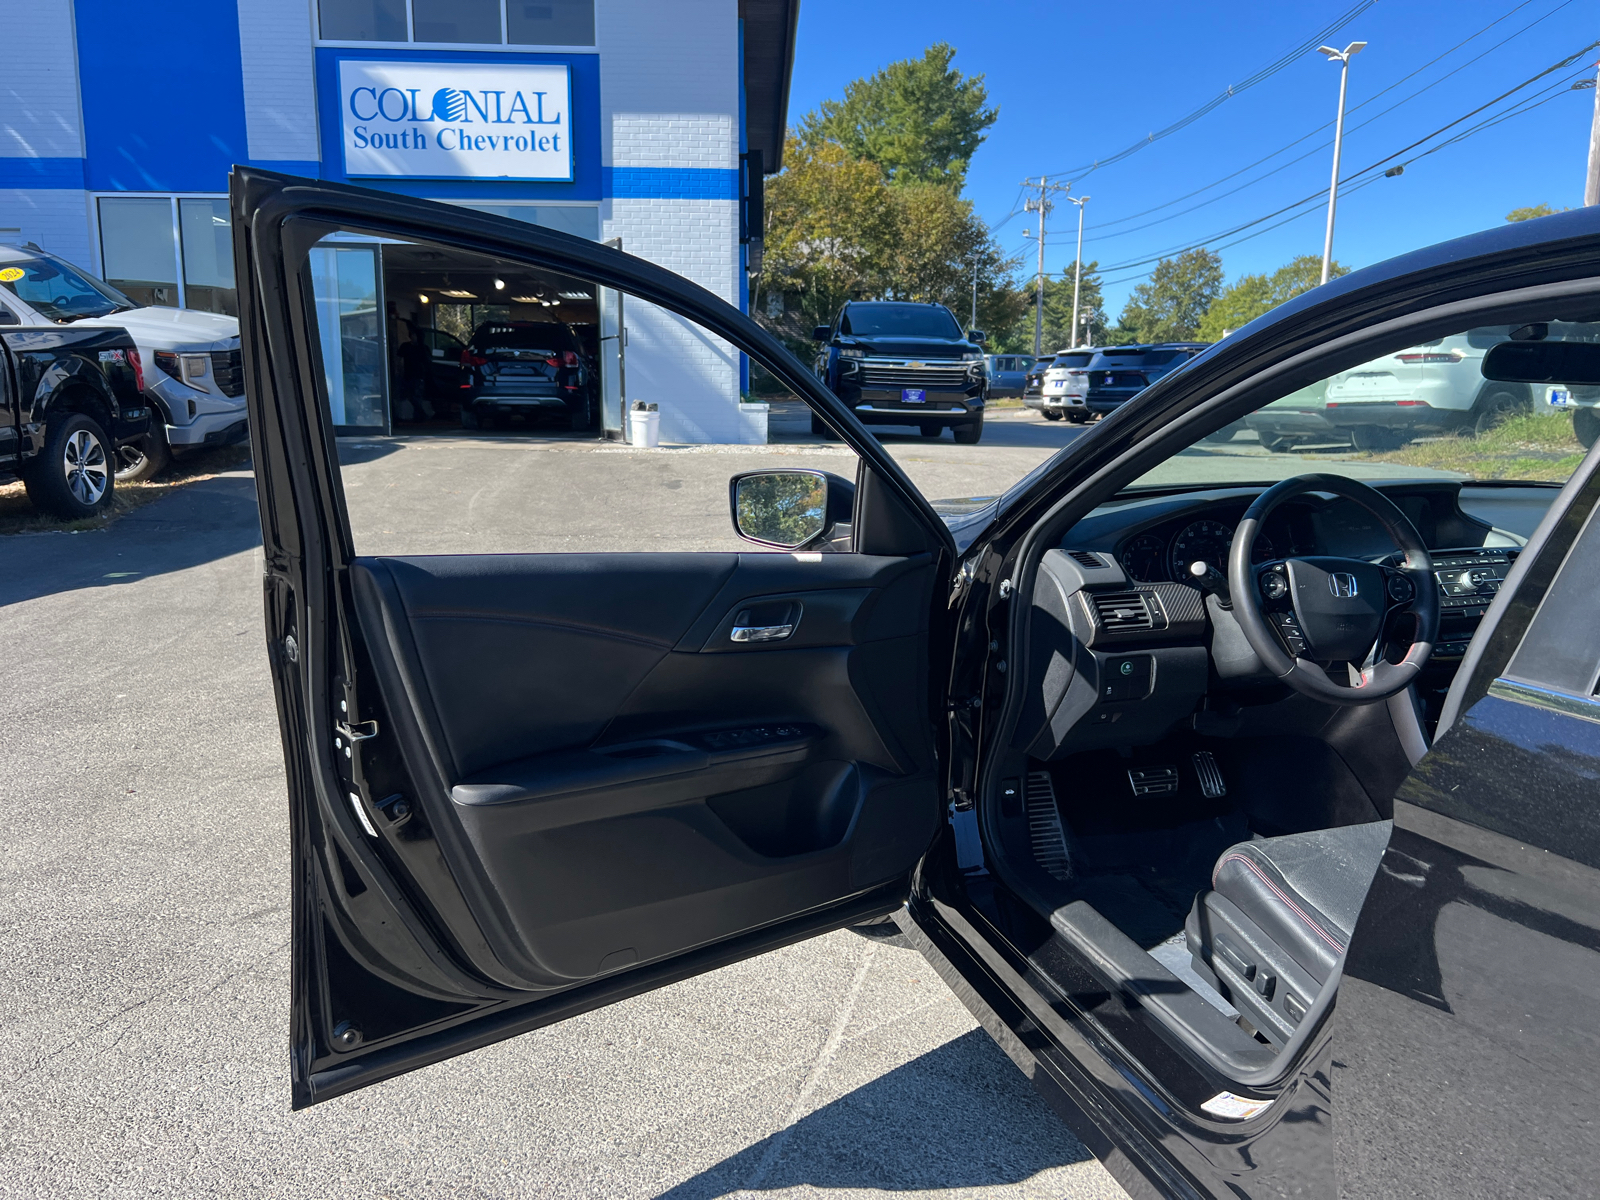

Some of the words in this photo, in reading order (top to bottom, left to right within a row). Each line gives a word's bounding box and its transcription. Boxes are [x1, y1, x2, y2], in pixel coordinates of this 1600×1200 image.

[350, 86, 561, 124] COLONIAL
[353, 126, 427, 149] South
[436, 127, 561, 152] Chevrolet
[1, 268, 21, 281] 2024
